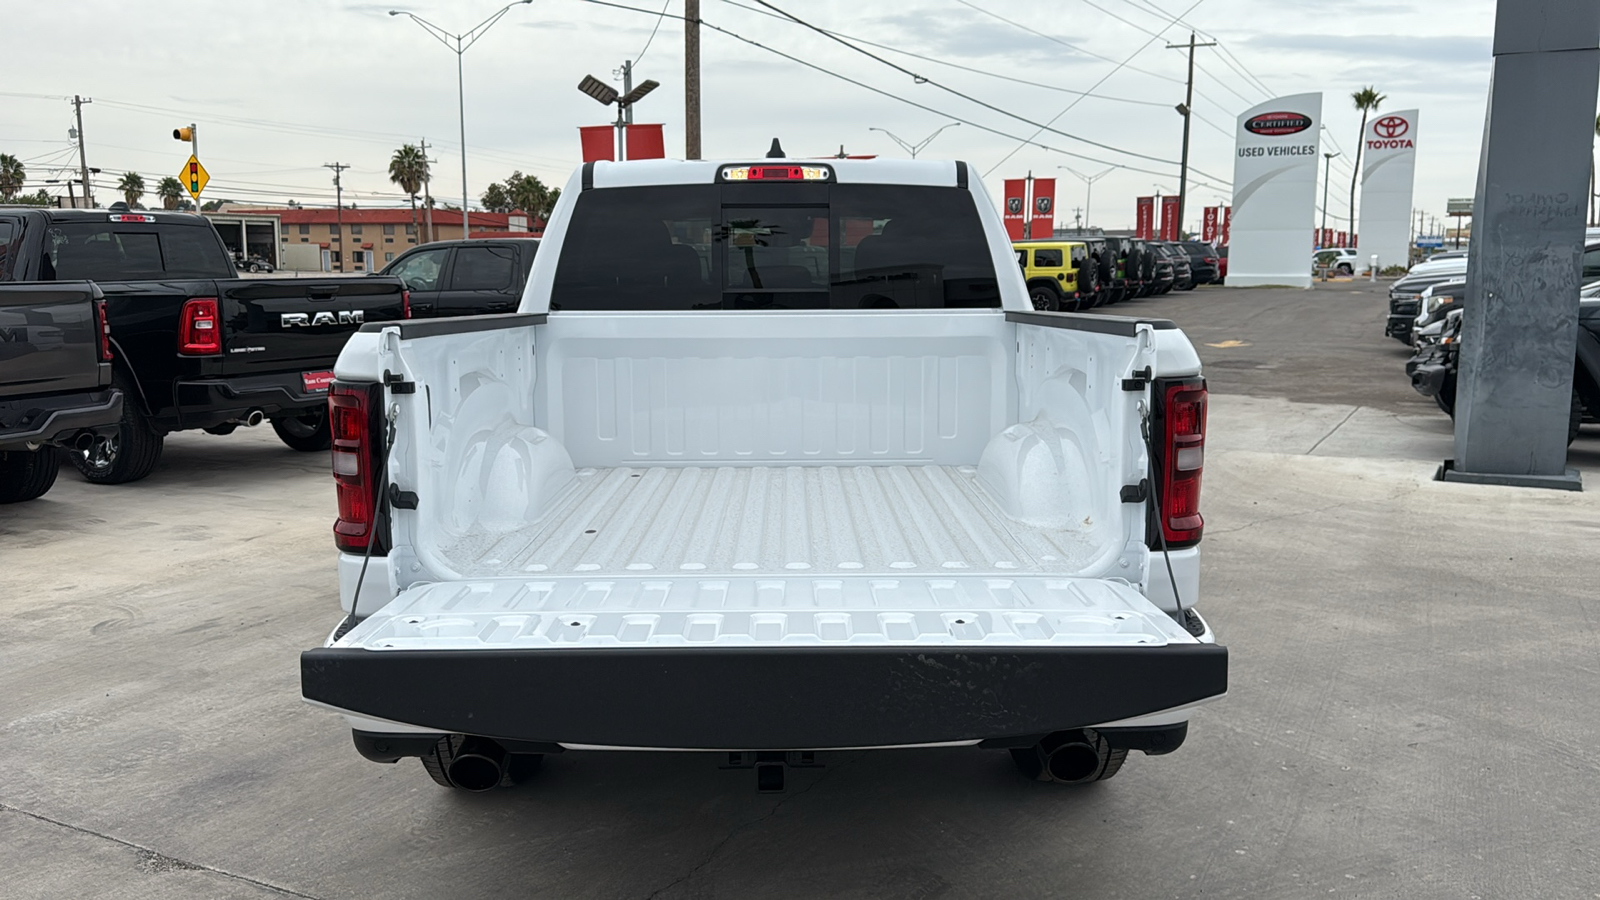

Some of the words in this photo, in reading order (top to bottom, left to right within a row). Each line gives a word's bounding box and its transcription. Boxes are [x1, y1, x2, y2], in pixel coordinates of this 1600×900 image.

[1252, 119, 1304, 128] CERTIFIED
[1367, 139, 1413, 149] TOYOTA
[1238, 146, 1264, 157] USED
[1267, 145, 1315, 156] VEHICLES
[1206, 208, 1215, 240] TOYOT
[281, 310, 364, 328] RAM
